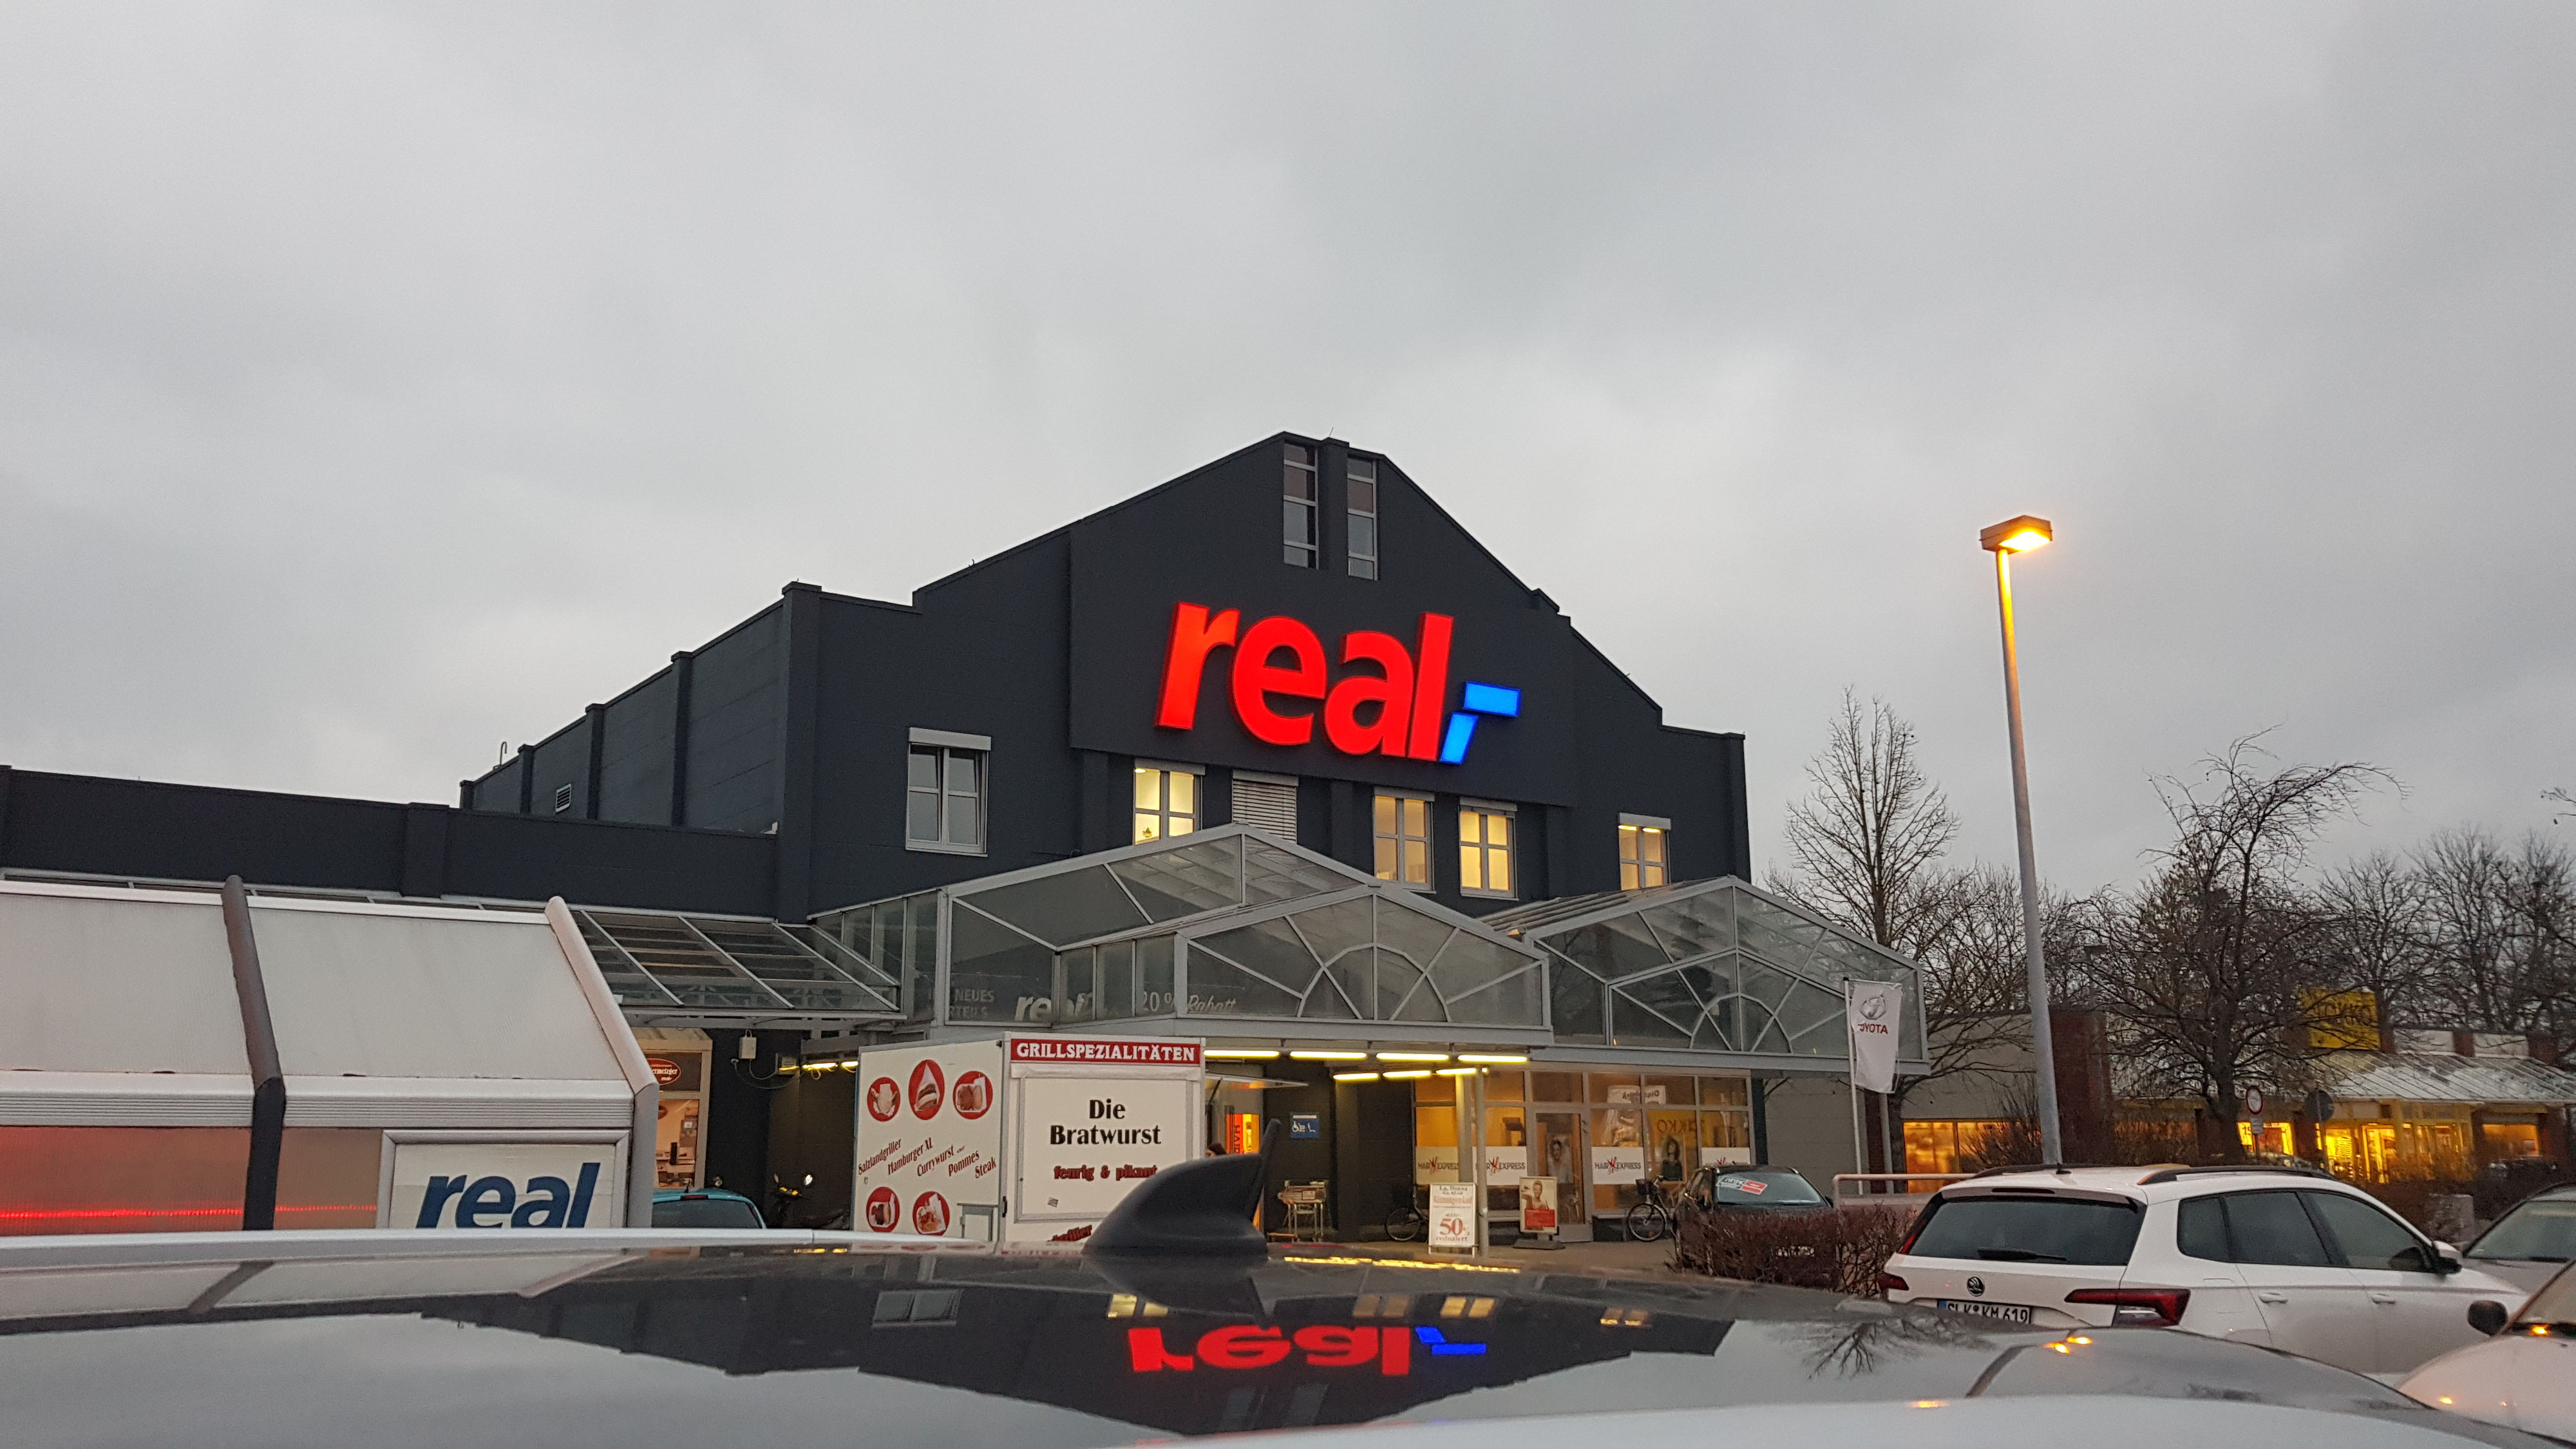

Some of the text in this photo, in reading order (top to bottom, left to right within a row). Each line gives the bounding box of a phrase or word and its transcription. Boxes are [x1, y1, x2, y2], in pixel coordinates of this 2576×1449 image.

[954, 989, 994, 1002] NEUES
[1188, 994, 1236, 1012] Rabatt
[1016, 1043, 1195, 1061] GRILLSPEZIALITÄTEN
[1089, 1099, 1126, 1119] Die
[1050, 1124, 1161, 1145] Bratwurst
[858, 1139, 901, 1175] Salzlandgriller
[888, 1137, 933, 1175] Hamburger XL
[917, 1144, 954, 1177] Currywurst
[948, 1150, 980, 1177] Pommes
[1499, 1162, 1526, 1170] EXPRESS
[1594, 1161, 1642, 1170] HAIR EXPRESS
[975, 1157, 996, 1179] Steak
[1054, 1164, 1158, 1182] feurig & pikant
[415, 1162, 601, 1229] real
